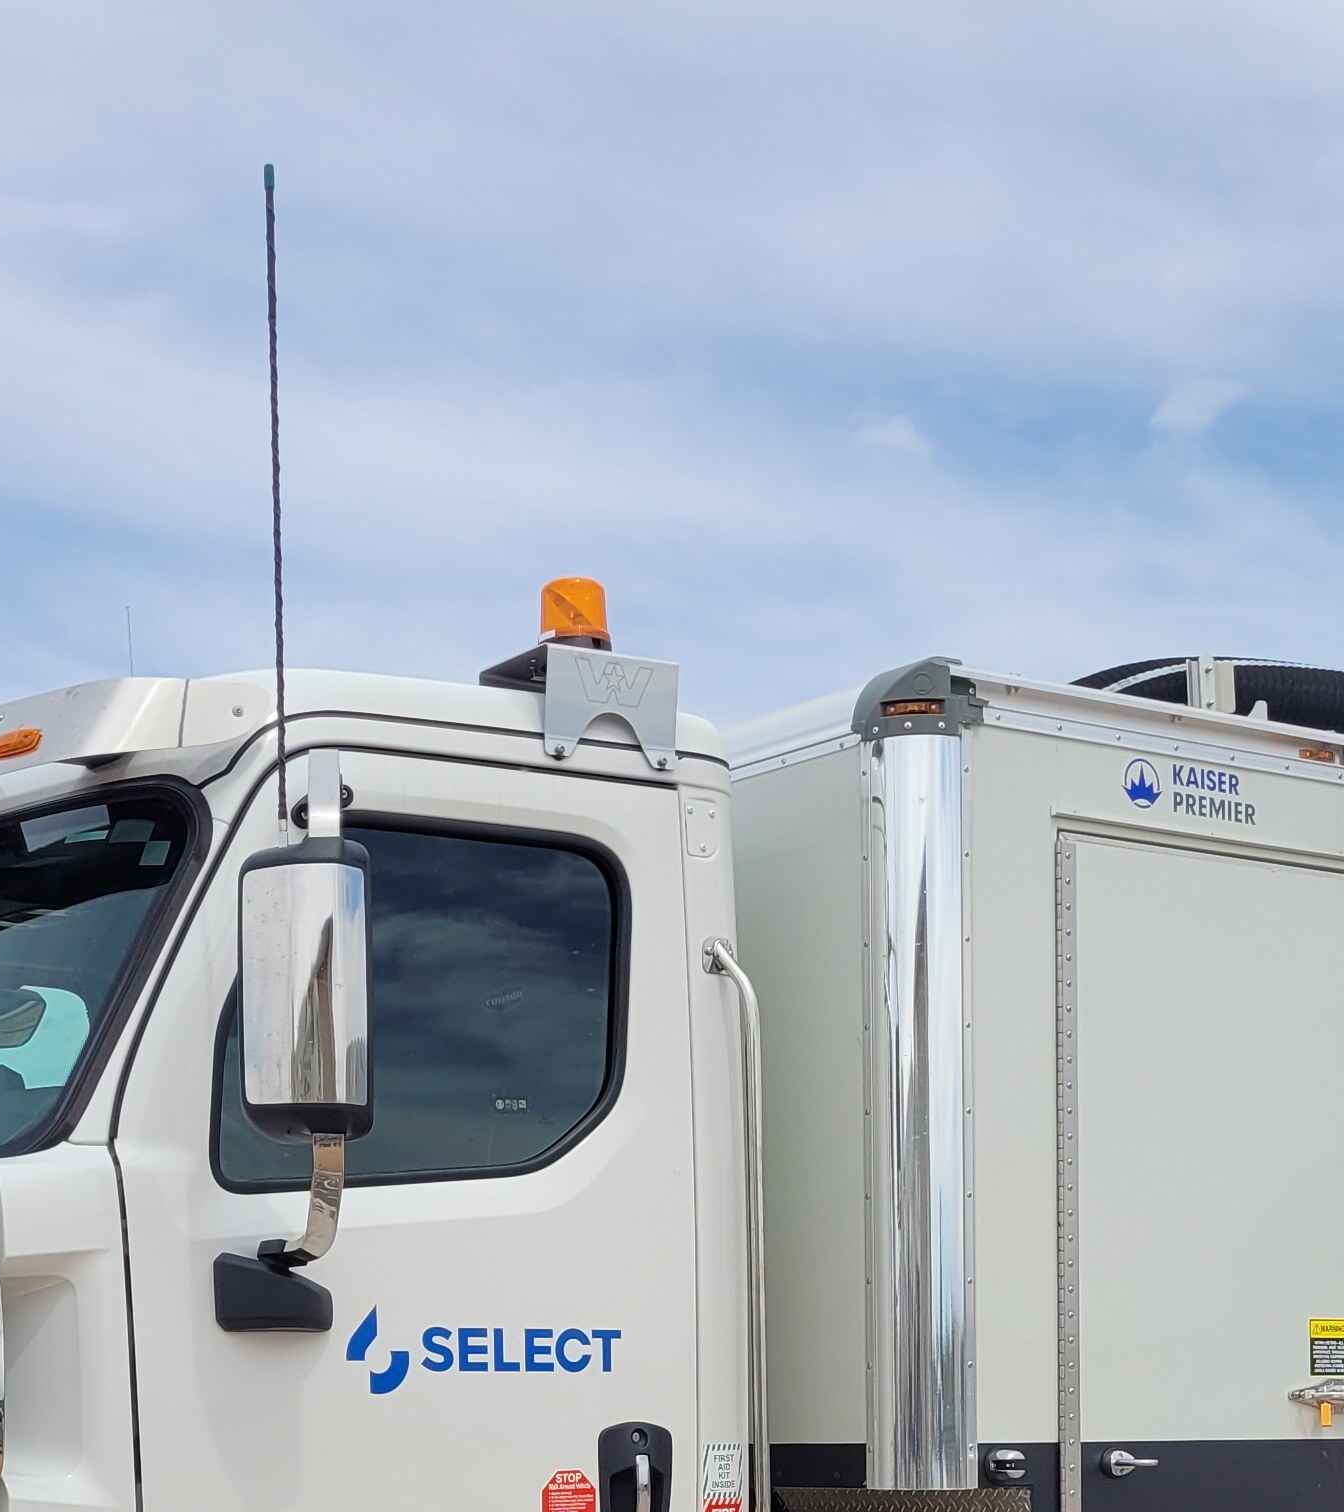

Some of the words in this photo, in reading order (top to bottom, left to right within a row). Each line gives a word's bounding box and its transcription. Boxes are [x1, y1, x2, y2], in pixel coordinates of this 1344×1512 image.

[1172, 763, 1240, 796] KAISER
[1172, 791, 1257, 826] PREMIER
[421, 1325, 622, 1373] SELECT
[713, 1454, 735, 1463] FIRST
[717, 1463, 731, 1471] AID
[555, 1472, 583, 1484] STOP
[718, 1471, 731, 1480] KIT
[711, 1480, 737, 1489] INSIDE
